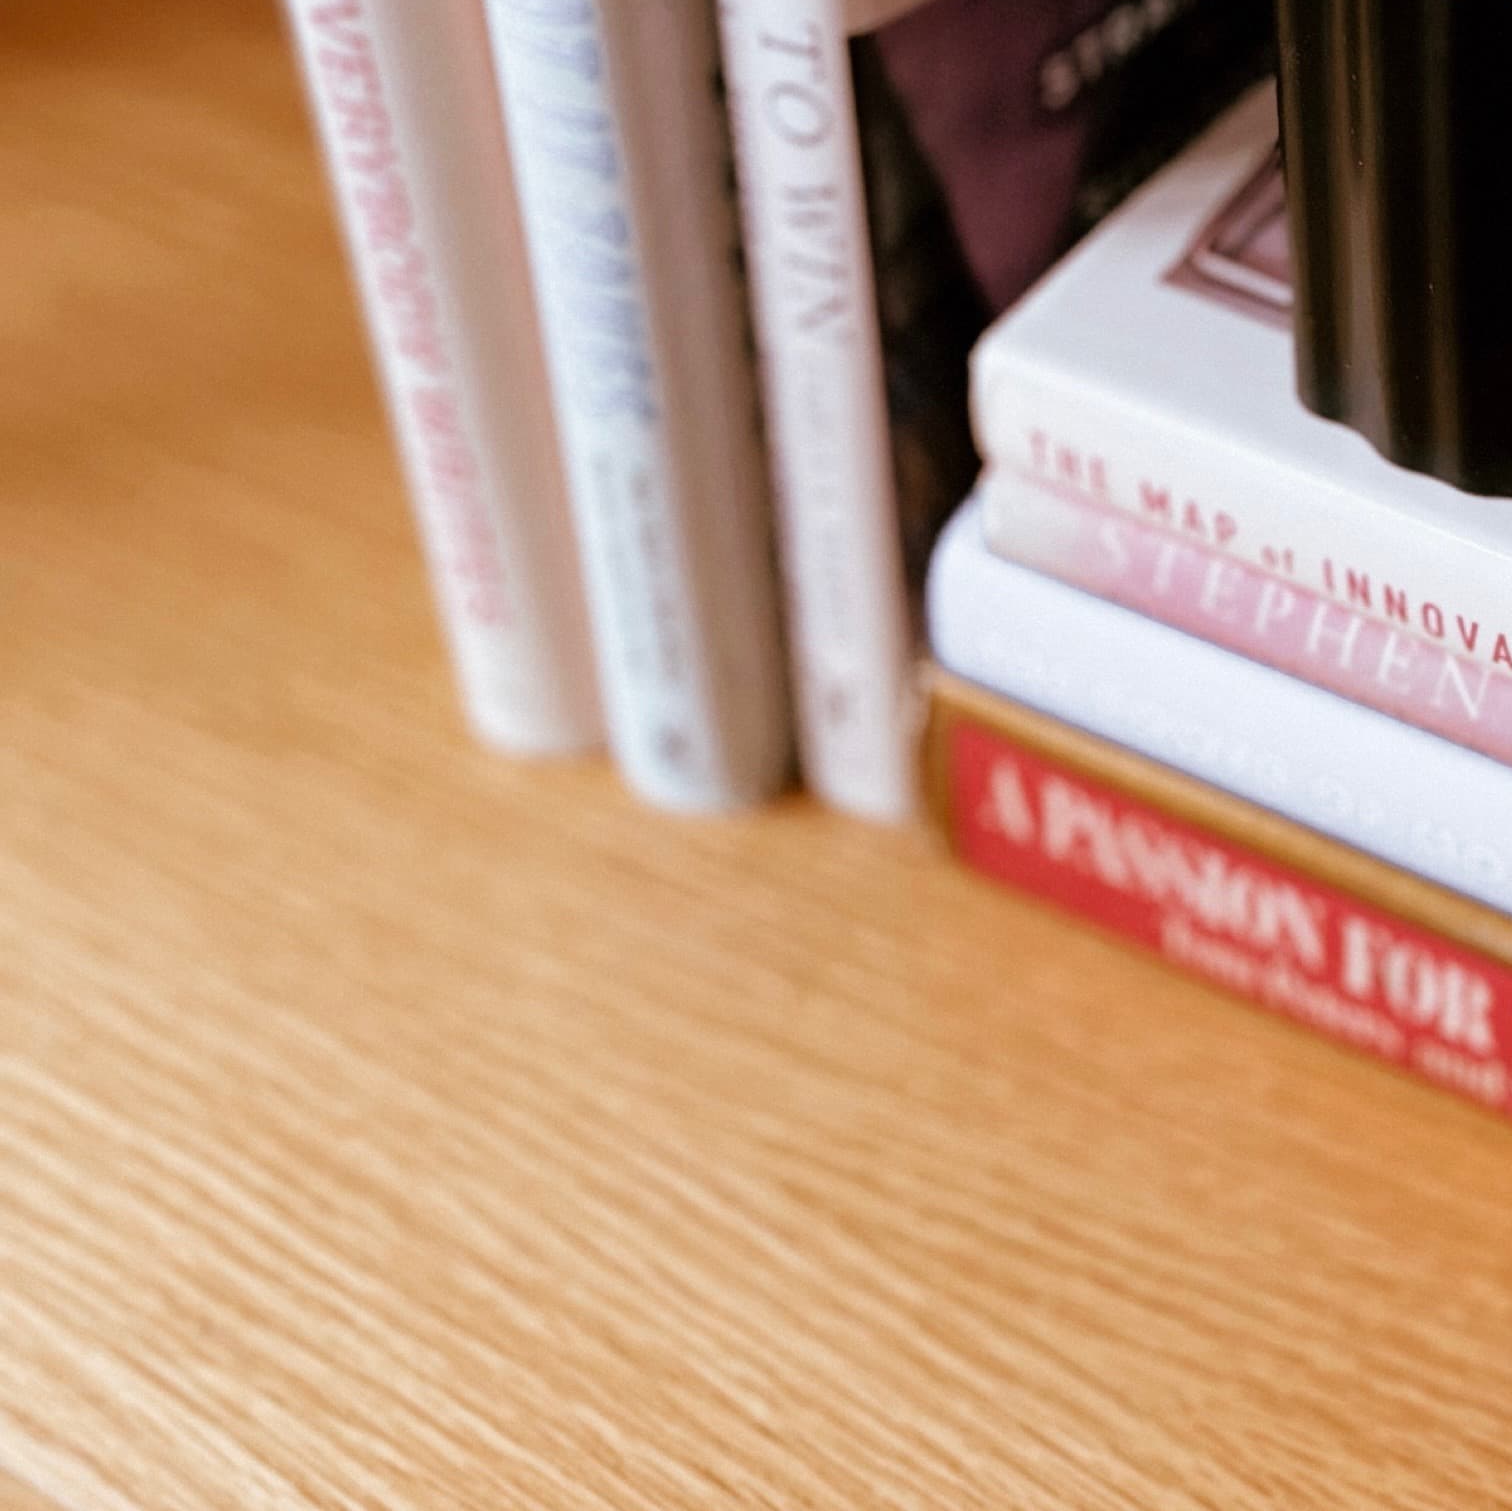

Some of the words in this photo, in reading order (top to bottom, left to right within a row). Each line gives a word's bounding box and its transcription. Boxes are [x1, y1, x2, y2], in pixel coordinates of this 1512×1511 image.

[1028, 428, 1108, 493] THE
[1139, 480, 1239, 547] MAP
[1098, 516, 1496, 724] STEPHEN
[1339, 915, 1496, 1053] FOR
